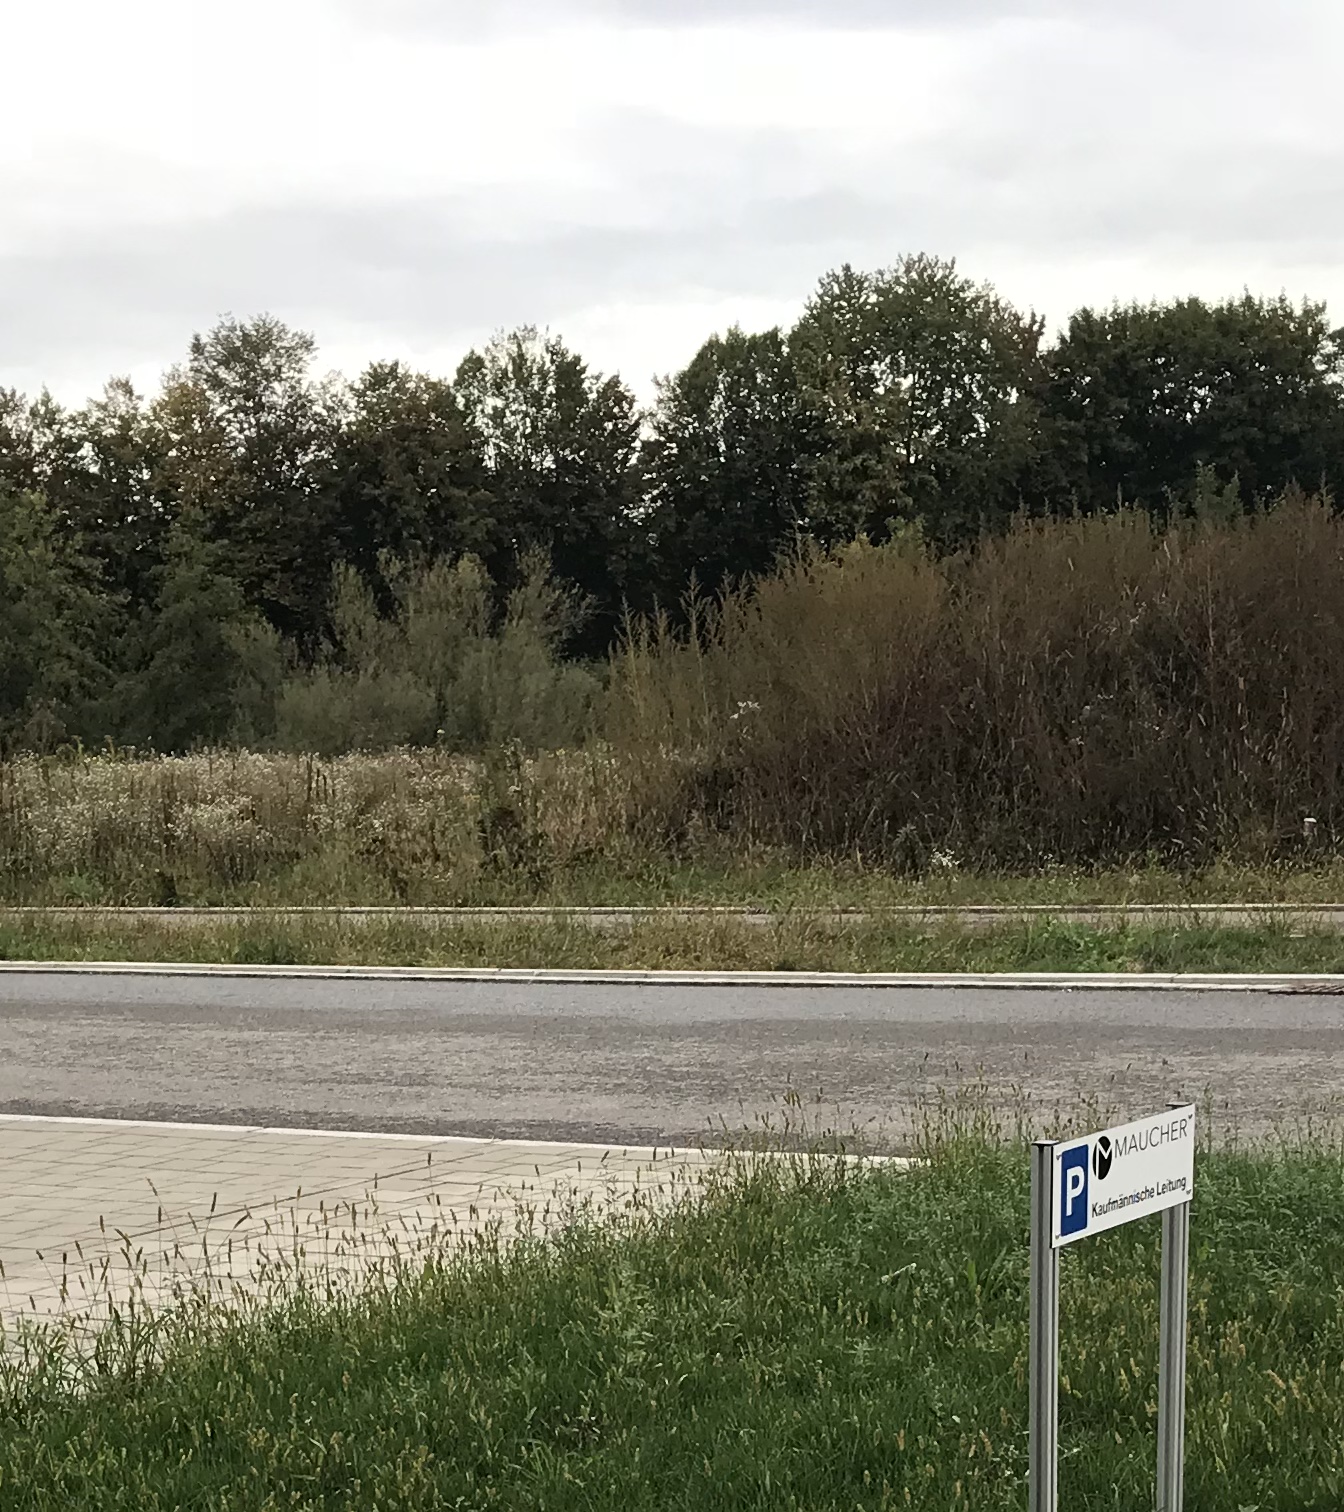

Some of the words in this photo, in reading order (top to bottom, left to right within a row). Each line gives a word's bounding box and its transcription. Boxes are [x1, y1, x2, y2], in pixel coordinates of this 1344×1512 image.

[1114, 1118, 1188, 1159] MAUCHER
[1092, 1185, 1155, 1218] Kaufmännische
[1156, 1176, 1187, 1195] Leitung
